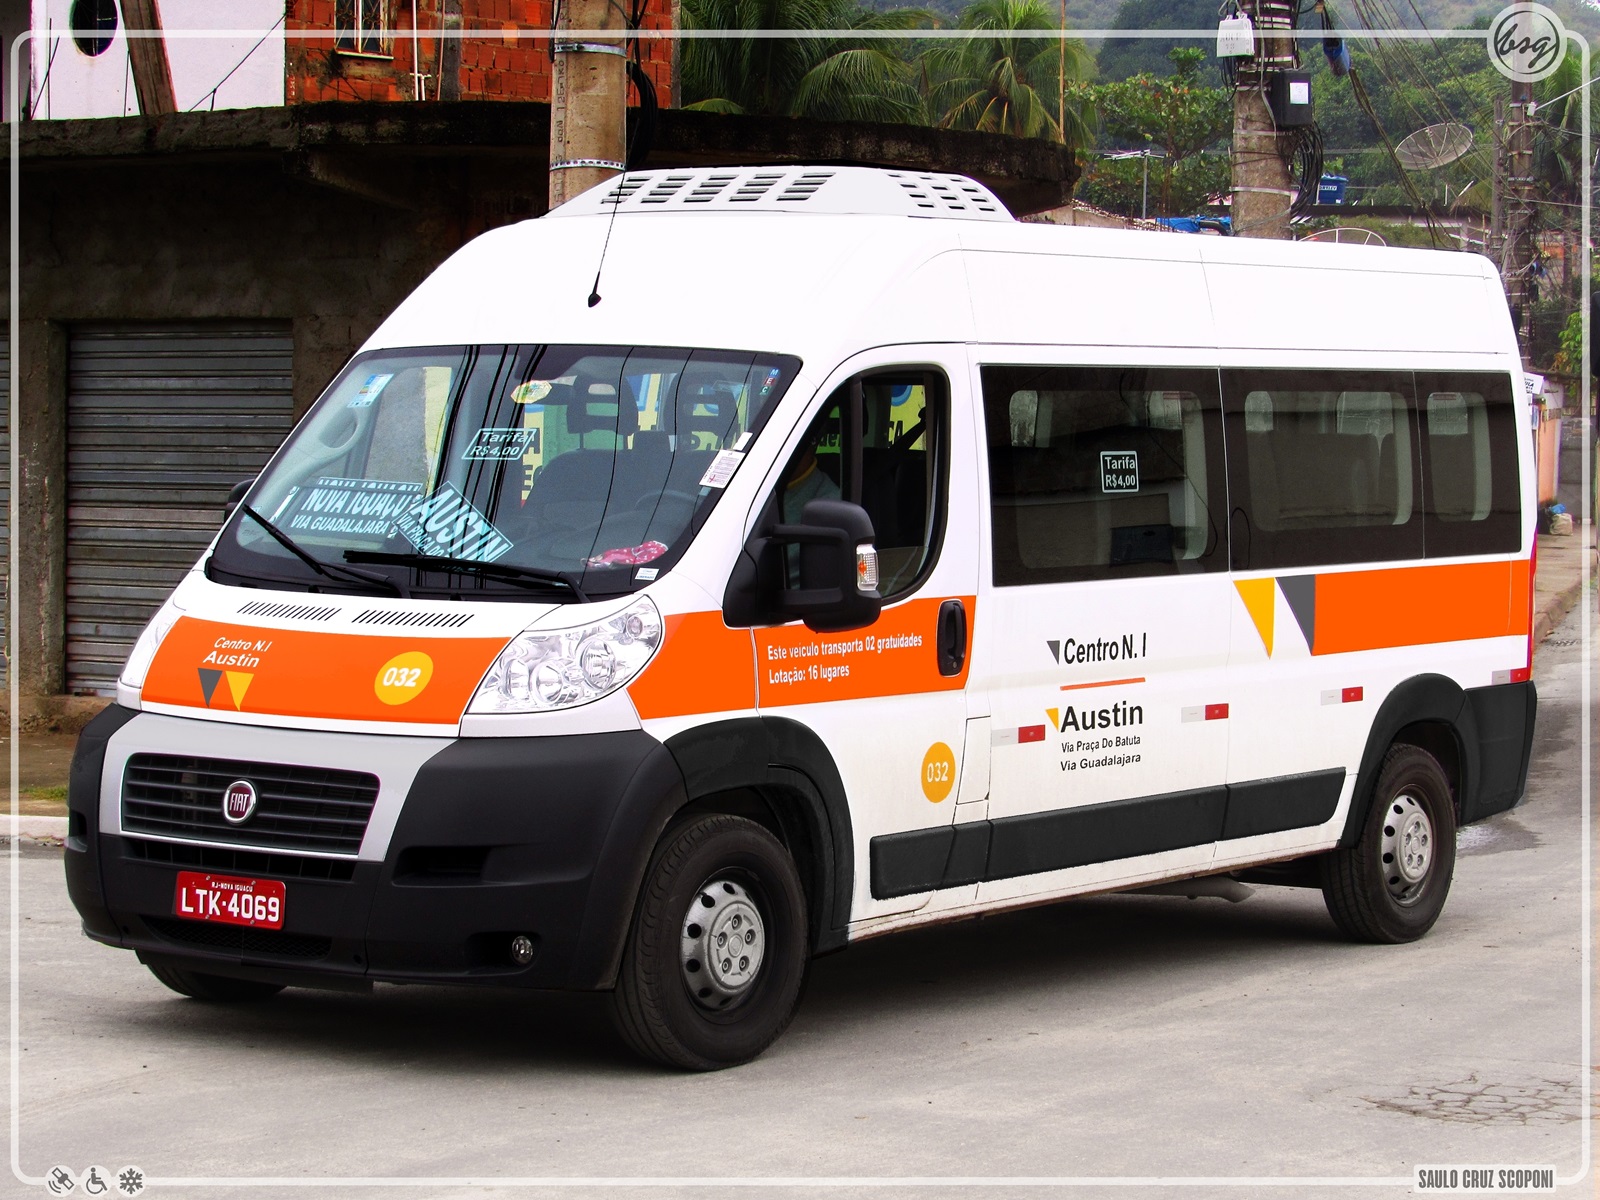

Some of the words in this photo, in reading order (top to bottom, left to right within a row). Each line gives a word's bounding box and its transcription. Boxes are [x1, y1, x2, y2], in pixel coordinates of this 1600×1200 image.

[481, 432, 529, 443] Tarifa
[469, 445, 520, 457] R$4,00
[1104, 456, 1136, 470] Tarifa
[1105, 473, 1136, 489] R$4,00
[290, 514, 312, 529] VIA
[310, 516, 391, 535] GUADALAJARA
[397, 513, 413, 532] VIA
[410, 488, 509, 563] AUSTIN
[213, 636, 252, 651] Centro
[767, 645, 787, 660] Este
[821, 638, 864, 657] transporta
[865, 635, 875, 651] 02
[877, 632, 922, 654] gratuidades
[1064, 637, 1119, 664] Centro
[202, 650, 260, 668] Austin
[382, 667, 421, 687] 032
[808, 664, 818, 680] 16
[820, 664, 850, 682] lugares
[1060, 700, 1143, 733] Austin
[1061, 742, 1074, 753] Via
[1076, 740, 1100, 752] Praça
[1102, 737, 1113, 748] Do
[1060, 760, 1077, 771] Via
[1079, 753, 1141, 769] Guadalajara
[927, 761, 949, 783] 032
[229, 792, 249, 812] FIAT
